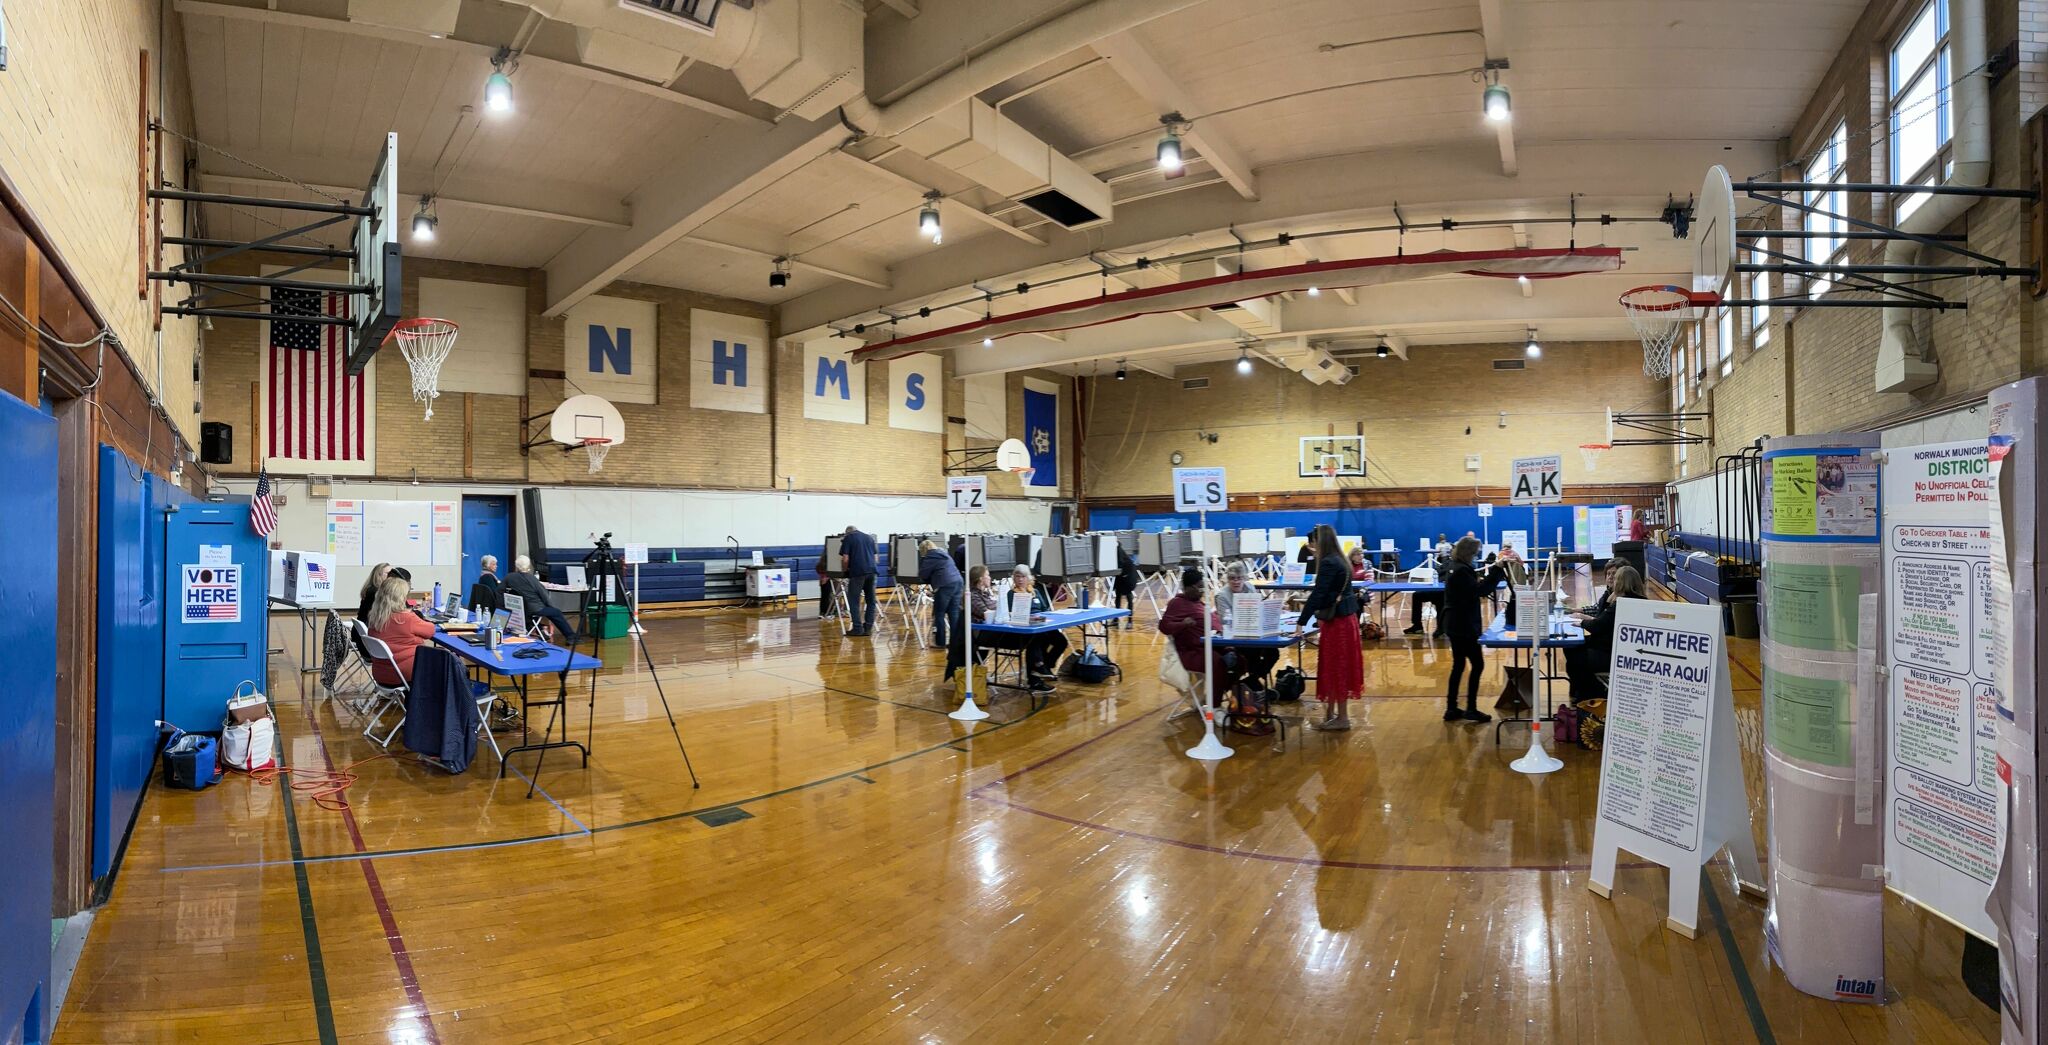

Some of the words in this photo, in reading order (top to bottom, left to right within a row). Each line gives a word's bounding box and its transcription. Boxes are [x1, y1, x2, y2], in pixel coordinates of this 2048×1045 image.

[588, 324, 632, 375] N
[712, 340, 747, 387] H
[815, 356, 851, 400] M
[905, 372, 925, 411] S
[1914, 450, 1951, 460] NORWALK
[1928, 459, 1989, 477] DISTRICT
[1514, 473, 1533, 497] A
[1541, 471, 1559, 496] K
[951, 489, 963, 507] T
[970, 489, 982, 507] Z
[1182, 483, 1196, 504] L
[1206, 482, 1221, 504] S
[1820, 497, 1826, 505] 2
[1859, 495, 1864, 505] 3
[1915, 493, 1955, 502] PERMITTED
[1948, 530, 1968, 538] TABLE
[1942, 540, 1968, 550] STREET
[188, 569, 237, 584] VOTE
[314, 582, 331, 590] VOTE
[188, 588, 237, 603] HERE
[1620, 626, 1663, 647] START
[1666, 632, 1709, 654] HERE
[1616, 655, 1671, 678] EMPEZAR
[1673, 664, 1709, 684] AQUÍ
[1910, 669, 1928, 681] NEED
[1929, 674, 1951, 686] HELP?
[1835, 975, 1877, 995] intab
